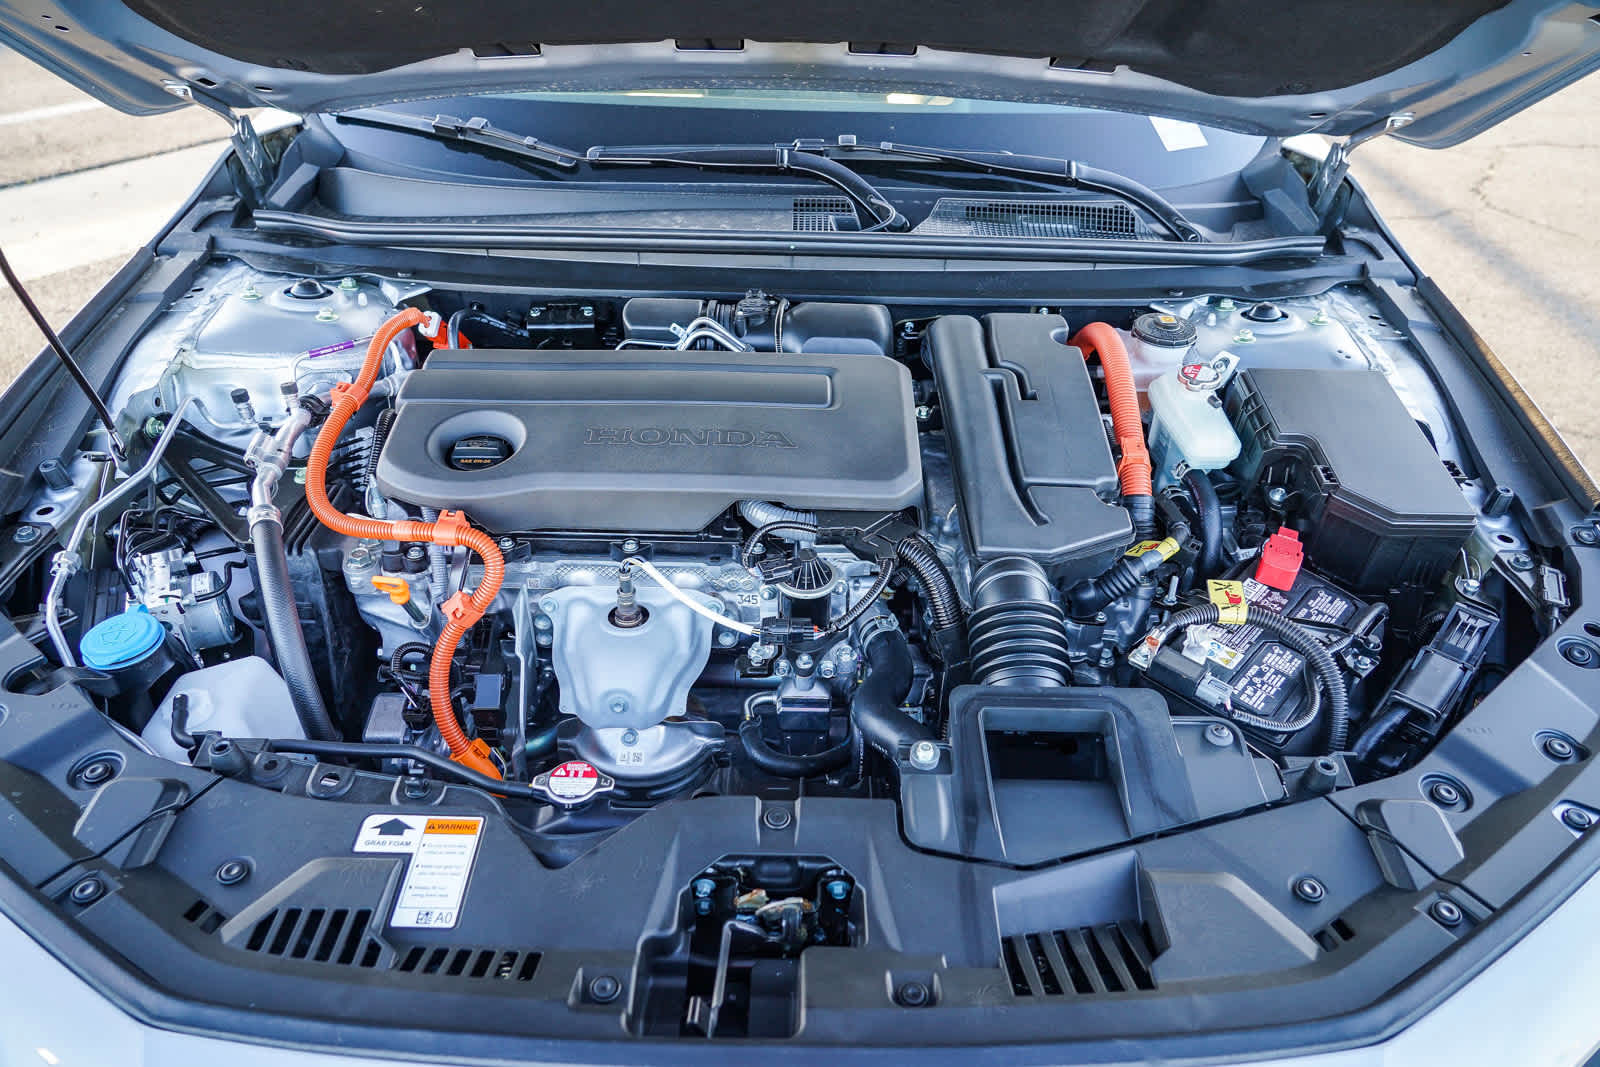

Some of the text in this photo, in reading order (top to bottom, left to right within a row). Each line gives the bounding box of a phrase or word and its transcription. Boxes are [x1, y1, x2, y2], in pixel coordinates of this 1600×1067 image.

[584, 425, 799, 449] HONDA
[437, 822, 477, 831] WARNING
[364, 839, 387, 847] GRAB
